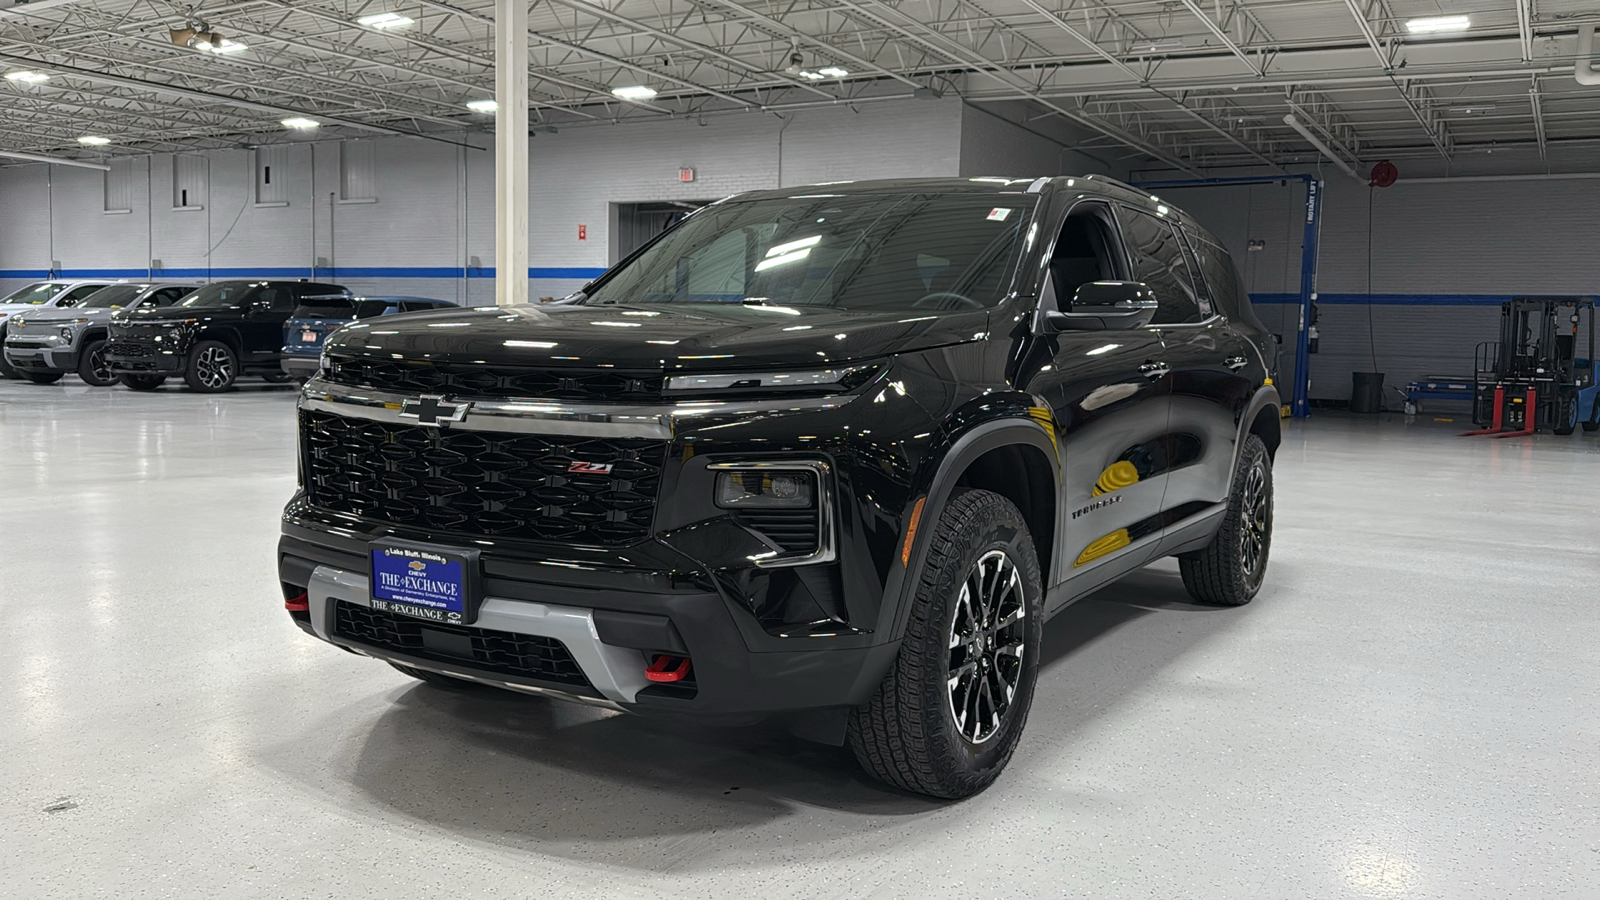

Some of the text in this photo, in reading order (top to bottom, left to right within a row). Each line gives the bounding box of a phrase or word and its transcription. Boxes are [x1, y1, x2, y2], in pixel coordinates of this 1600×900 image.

[568, 461, 613, 474] Z71
[1071, 495, 1122, 520] TRAVERSE
[390, 548, 404, 556] Lake
[421, 552, 442, 561] Illinois
[380, 572, 458, 596] THE EXCHANGE
[372, 599, 443, 620] THE EXCHANGE
[392, 594, 447, 608] www.chevyexchange.com
